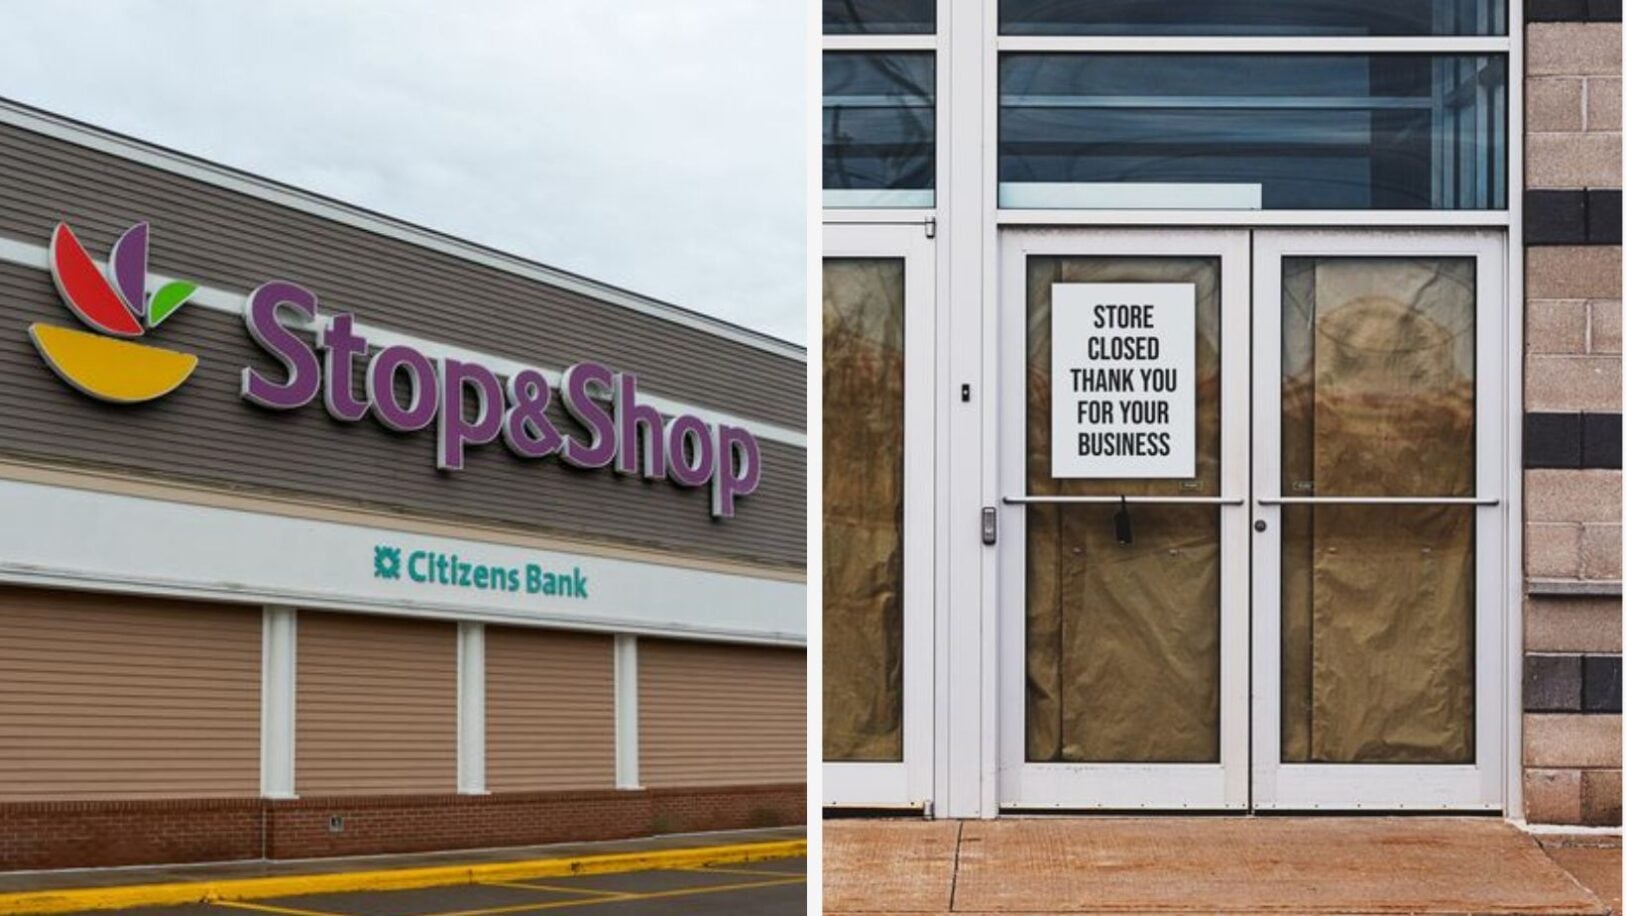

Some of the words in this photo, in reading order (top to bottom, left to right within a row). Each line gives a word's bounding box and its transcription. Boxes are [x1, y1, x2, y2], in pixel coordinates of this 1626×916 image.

[1093, 304, 1154, 329] STORE
[1088, 336, 1160, 360] CLOSED
[1070, 368, 1134, 393] THANK
[1140, 368, 1177, 393] YOU
[1077, 400, 1113, 424] FOR
[1119, 400, 1169, 424] YOUR
[1078, 432, 1171, 456] BUSINESS
[407, 550, 520, 592] Citizens
[525, 563, 589, 599] Bank
